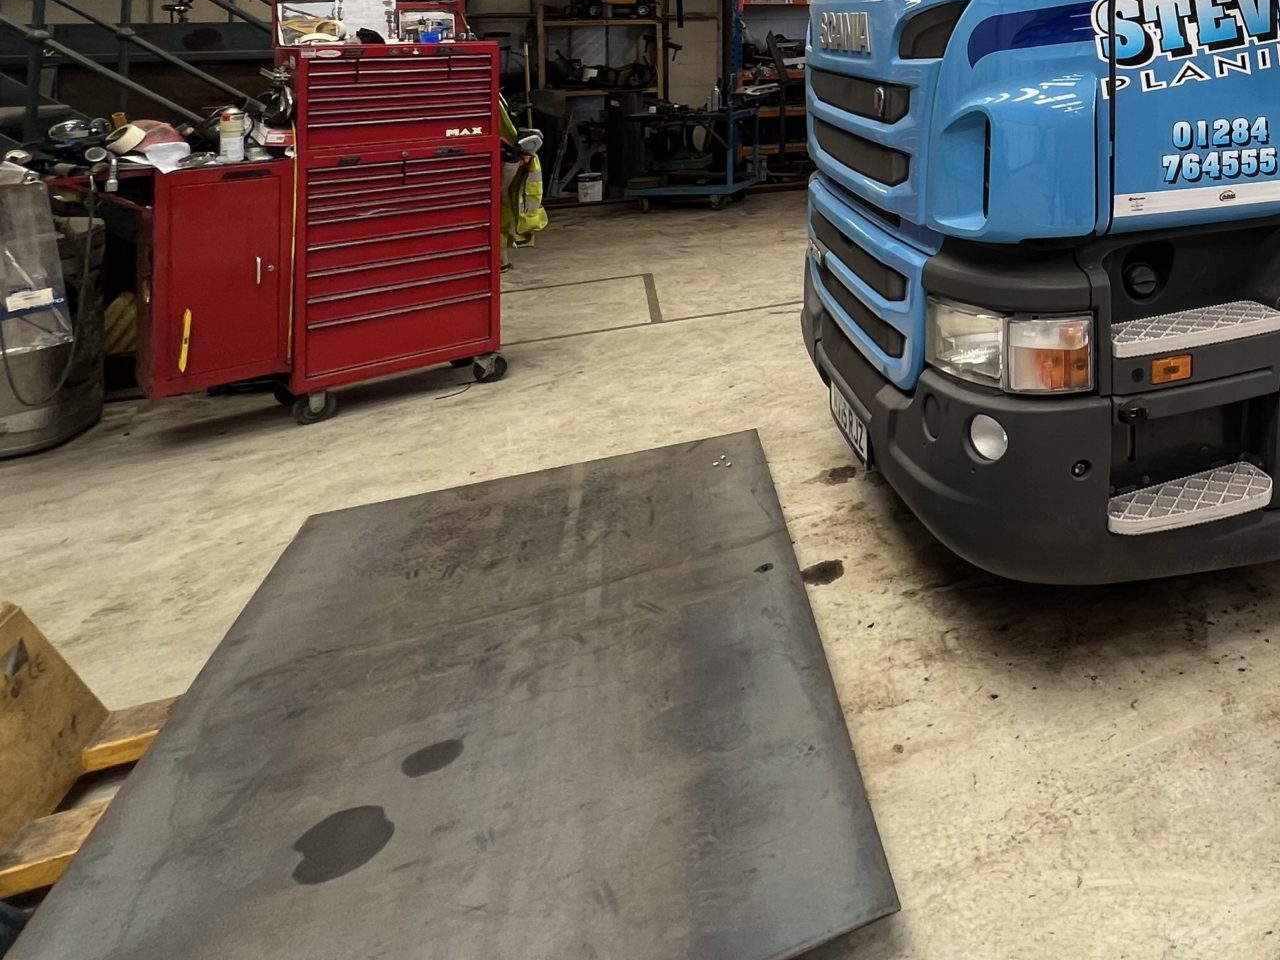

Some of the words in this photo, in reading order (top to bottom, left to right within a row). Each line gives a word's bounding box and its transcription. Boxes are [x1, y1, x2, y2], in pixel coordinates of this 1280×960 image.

[819, 11, 871, 53] SCANIA
[445, 126, 483, 137] MAX
[1171, 116, 1270, 151] 01284
[1161, 147, 1279, 184] 764555
